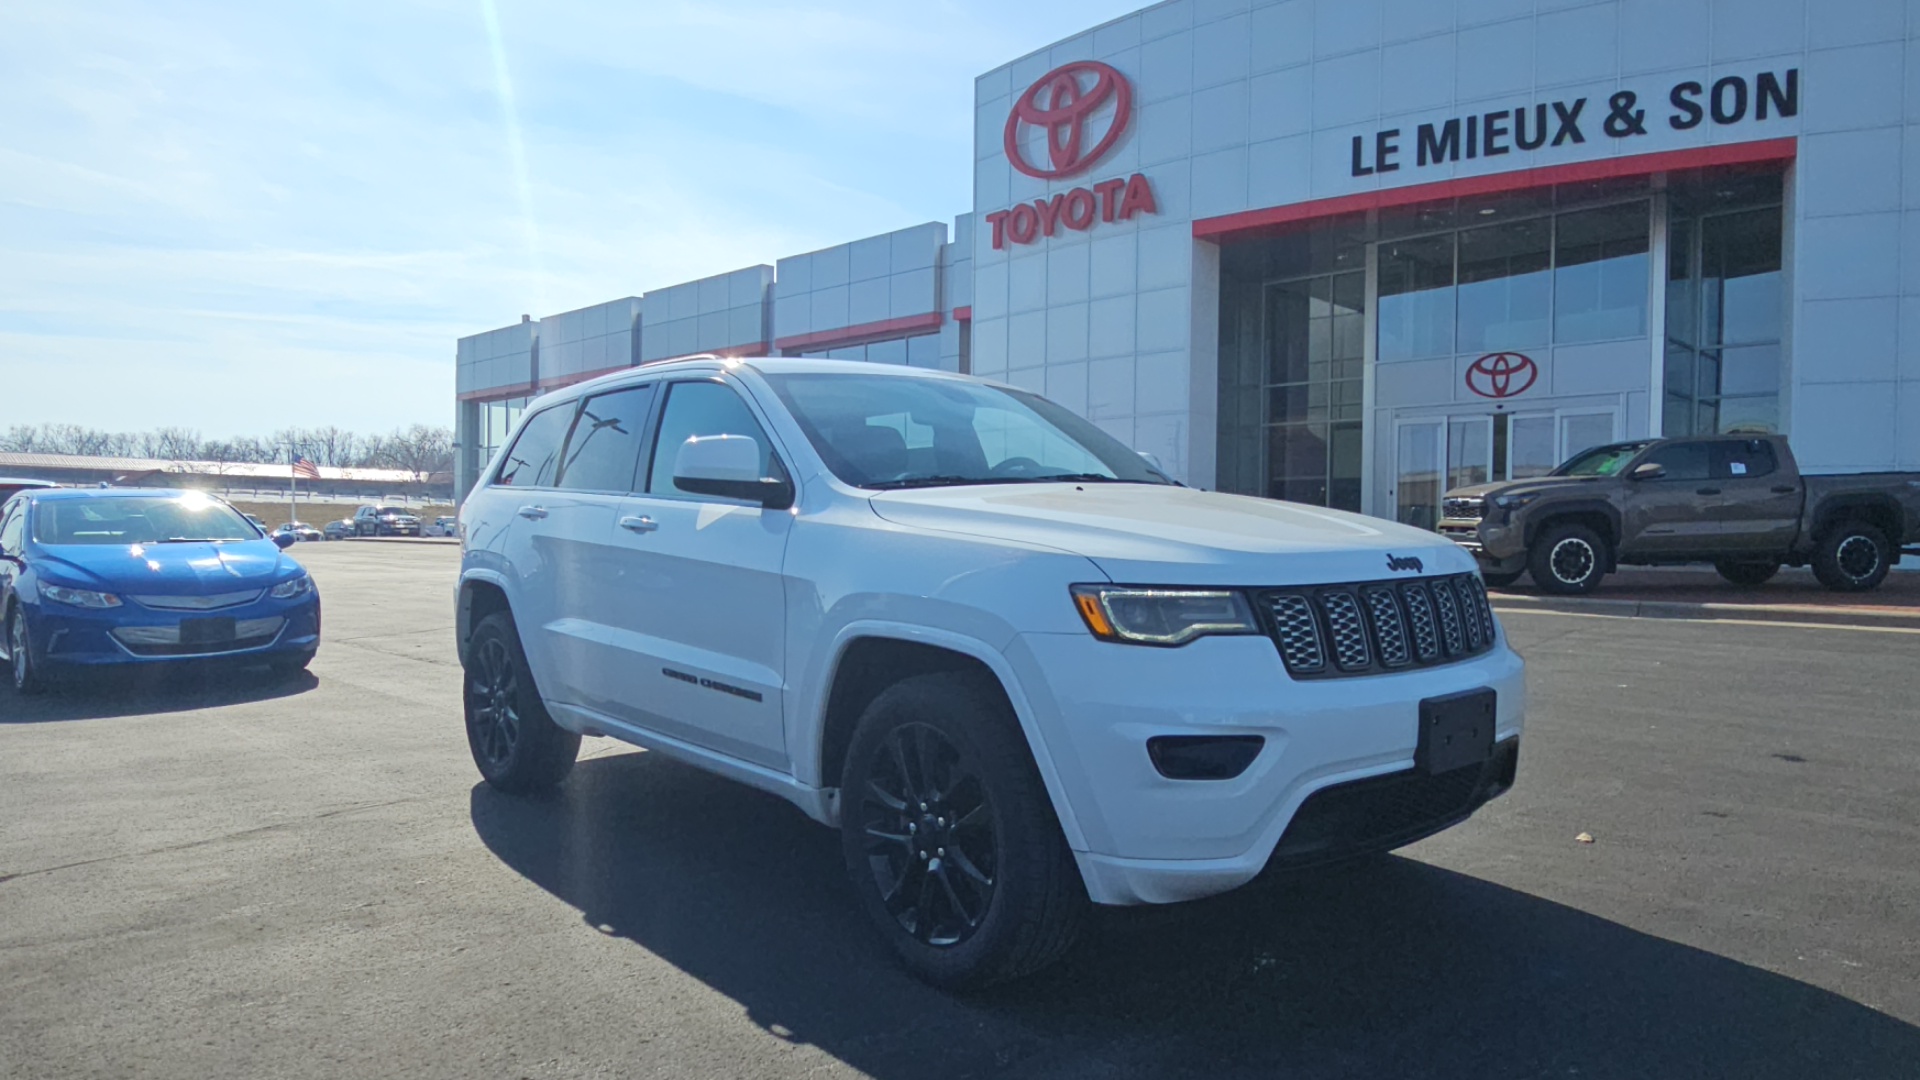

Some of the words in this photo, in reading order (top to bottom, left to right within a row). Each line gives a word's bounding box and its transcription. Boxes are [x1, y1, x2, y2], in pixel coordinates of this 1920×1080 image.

[1351, 129, 1400, 177] LE
[1416, 98, 1588, 167] MIEUX
[1603, 90, 1647, 138] &
[1669, 68, 1799, 130] SON
[985, 173, 1157, 250] TOYOTA
